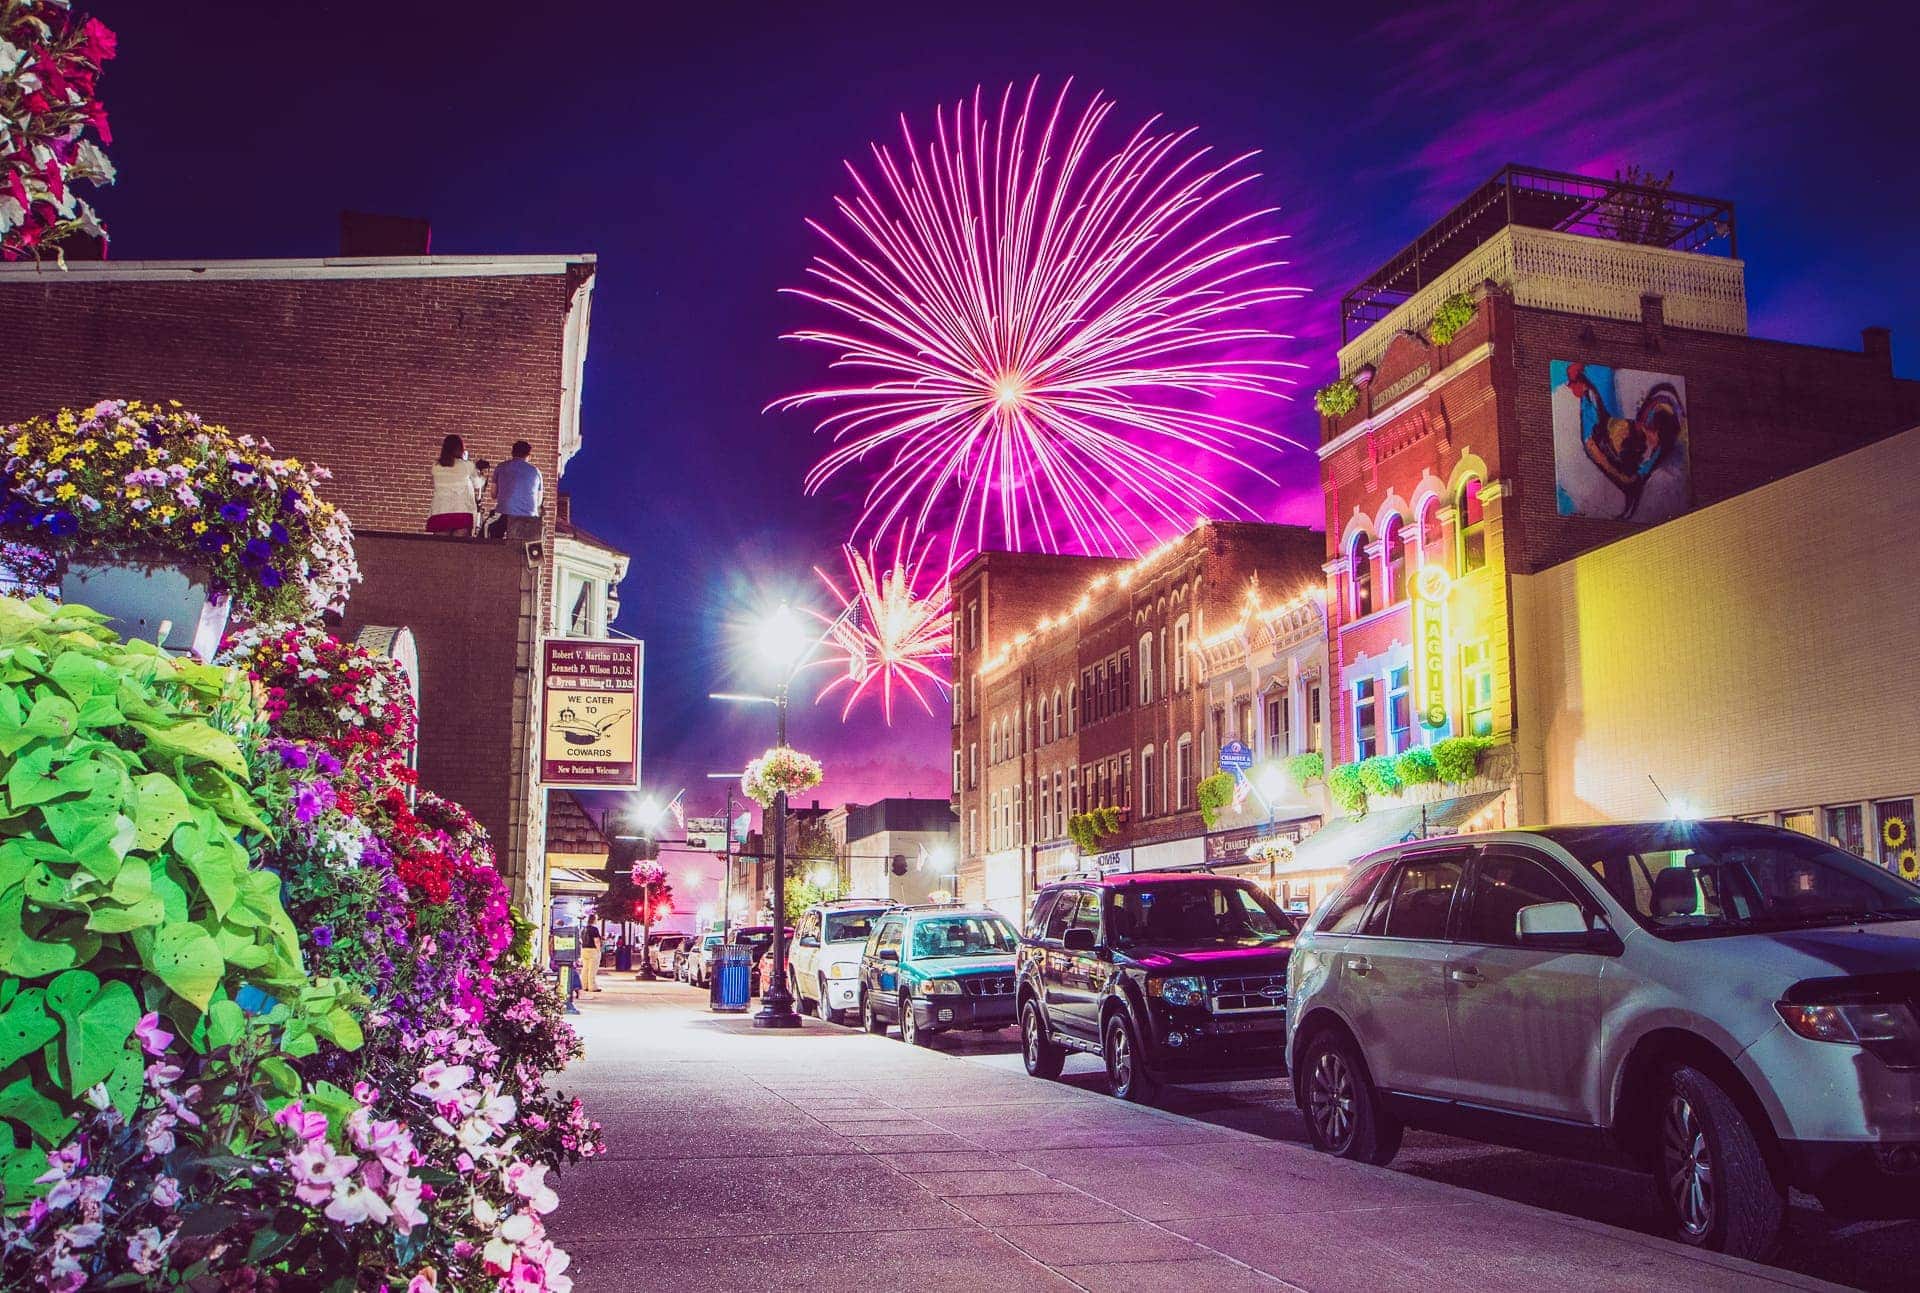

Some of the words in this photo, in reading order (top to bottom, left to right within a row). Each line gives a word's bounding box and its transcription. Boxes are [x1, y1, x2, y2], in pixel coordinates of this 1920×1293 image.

[552, 649, 573, 660] Robert
[576, 650, 583, 660] V.
[585, 650, 611, 661] Martino
[612, 652, 633, 662] D.D.S.
[551, 663, 578, 673] Kenneth
[580, 664, 587, 673] P.
[589, 664, 611, 674] Wilson
[612, 666, 633, 675] D.D.S.
[1425, 605, 1445, 723] MAGGIES
[556, 678, 577, 688] Byron
[616, 679, 635, 689] D.D.S.
[568, 695, 582, 704] WE
[585, 696, 614, 705] CATER
[585, 706, 597, 714] TO
[566, 748, 612, 757] COWARDS
[558, 765, 570, 774] New
[571, 765, 595, 774] Patients
[595, 766, 620, 775] Welcome
[1224, 838, 1249, 851] CHAMBER
